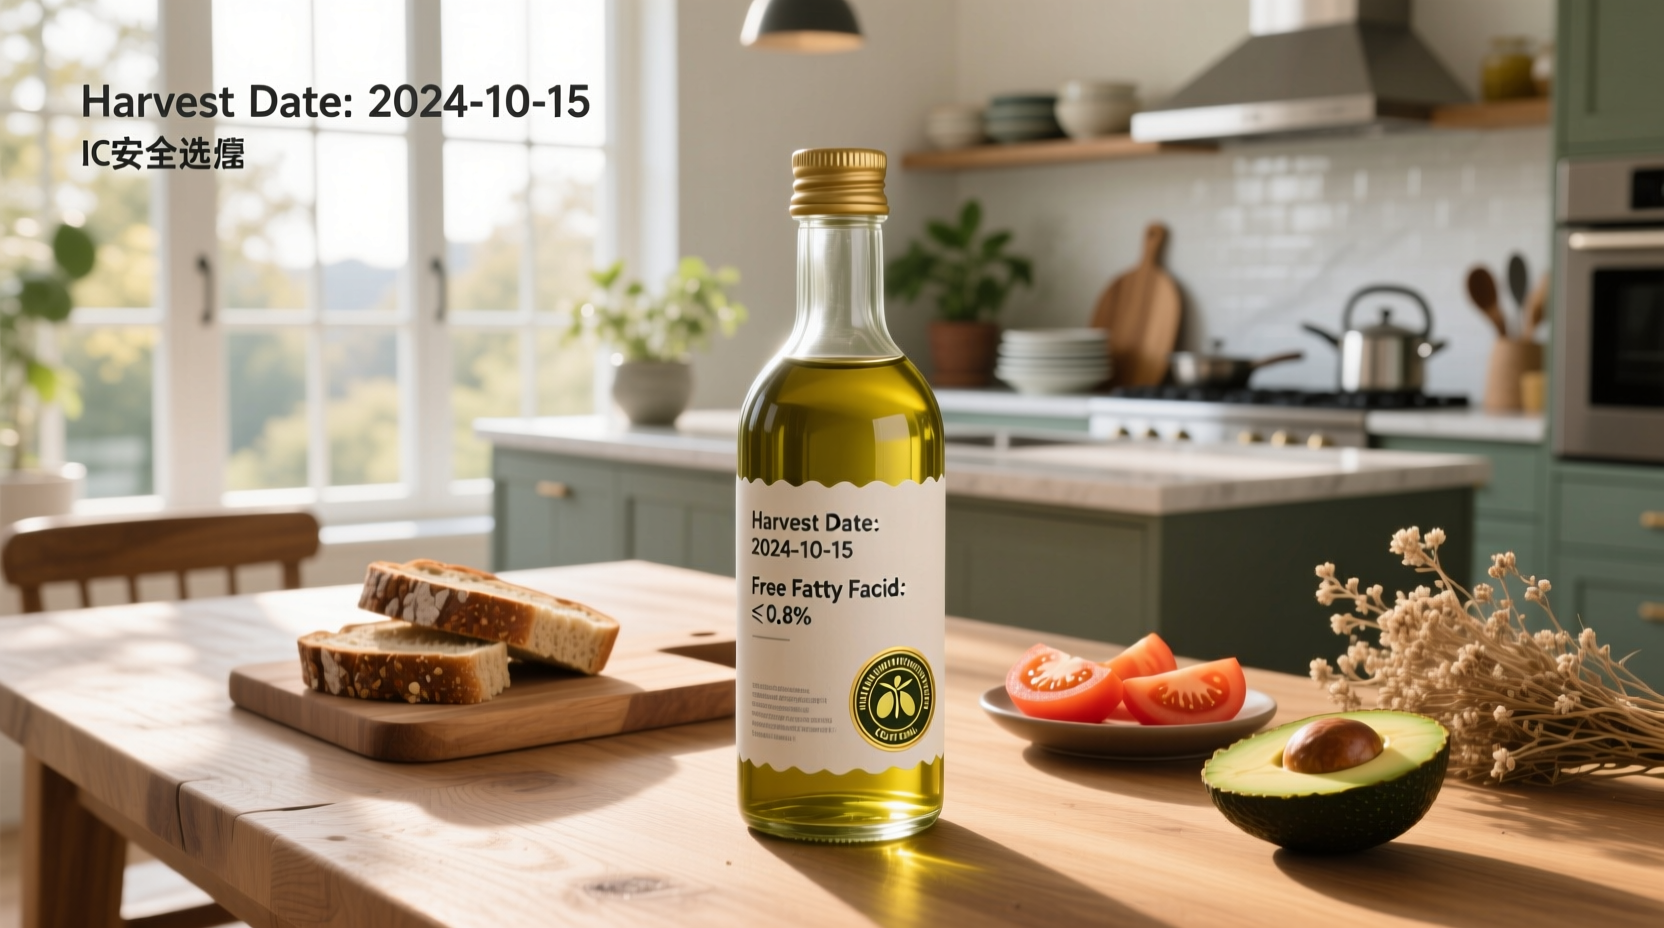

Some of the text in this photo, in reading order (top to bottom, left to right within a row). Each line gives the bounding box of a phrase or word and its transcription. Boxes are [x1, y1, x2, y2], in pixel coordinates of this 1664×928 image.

[752, 509, 879, 532] Harvest Date:
[751, 537, 854, 560] 2024-10-15
[751, 575, 906, 604] Free Fatty Facid:
